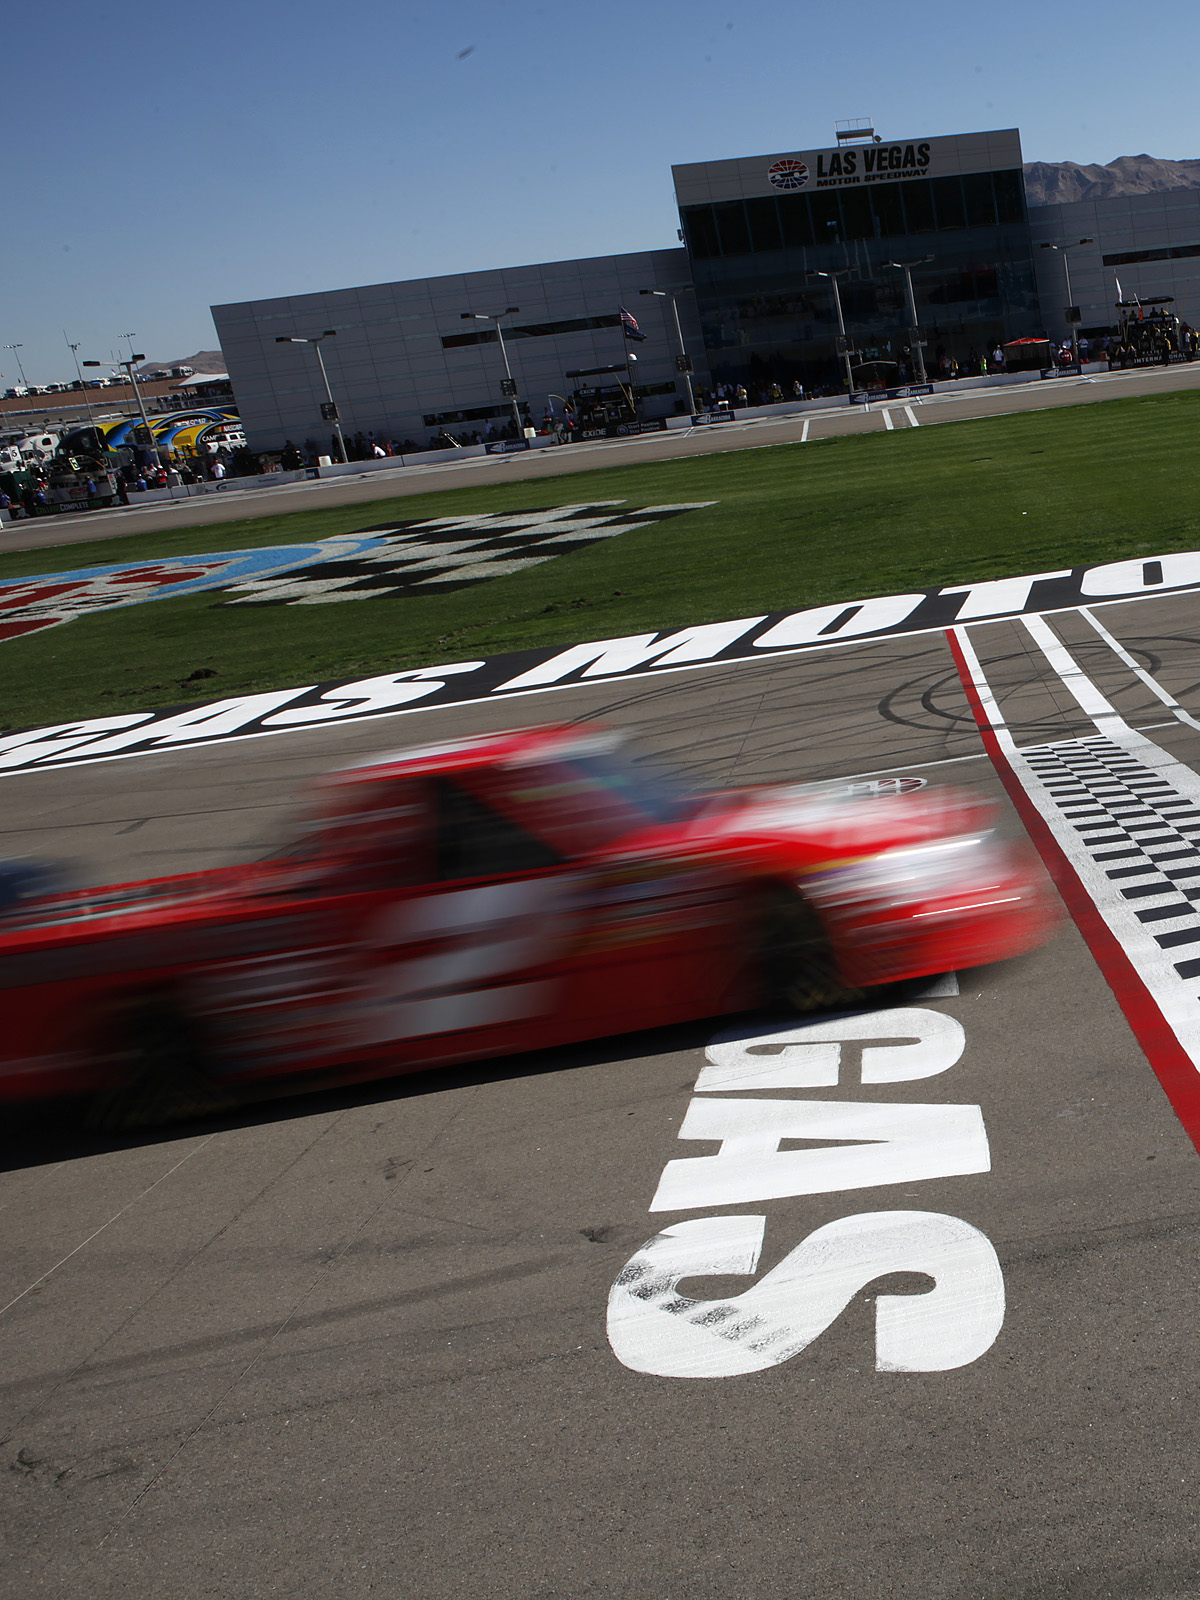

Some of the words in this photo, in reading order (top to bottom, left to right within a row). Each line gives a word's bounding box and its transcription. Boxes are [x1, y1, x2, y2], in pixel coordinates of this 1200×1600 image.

[817, 151, 857, 178] LAS
[863, 143, 930, 172] VEGAS
[816, 176, 860, 187] MOTOR
[864, 168, 929, 183] SPEEDWAY
[1133, 352, 1187, 364] INTERNAONAL
[1053, 368, 1078, 378] BARRACUDA
[861, 392, 888, 404] BARRACUDA
[904, 386, 931, 398] BARRACUDA
[704, 412, 731, 425] BARRACUDA
[223, 423, 242, 432] NASCAR
[583, 428, 607, 438] EXIDE
[499, 442, 527, 453] BARRACUDA
[607, 970, 1006, 1378] GAS
